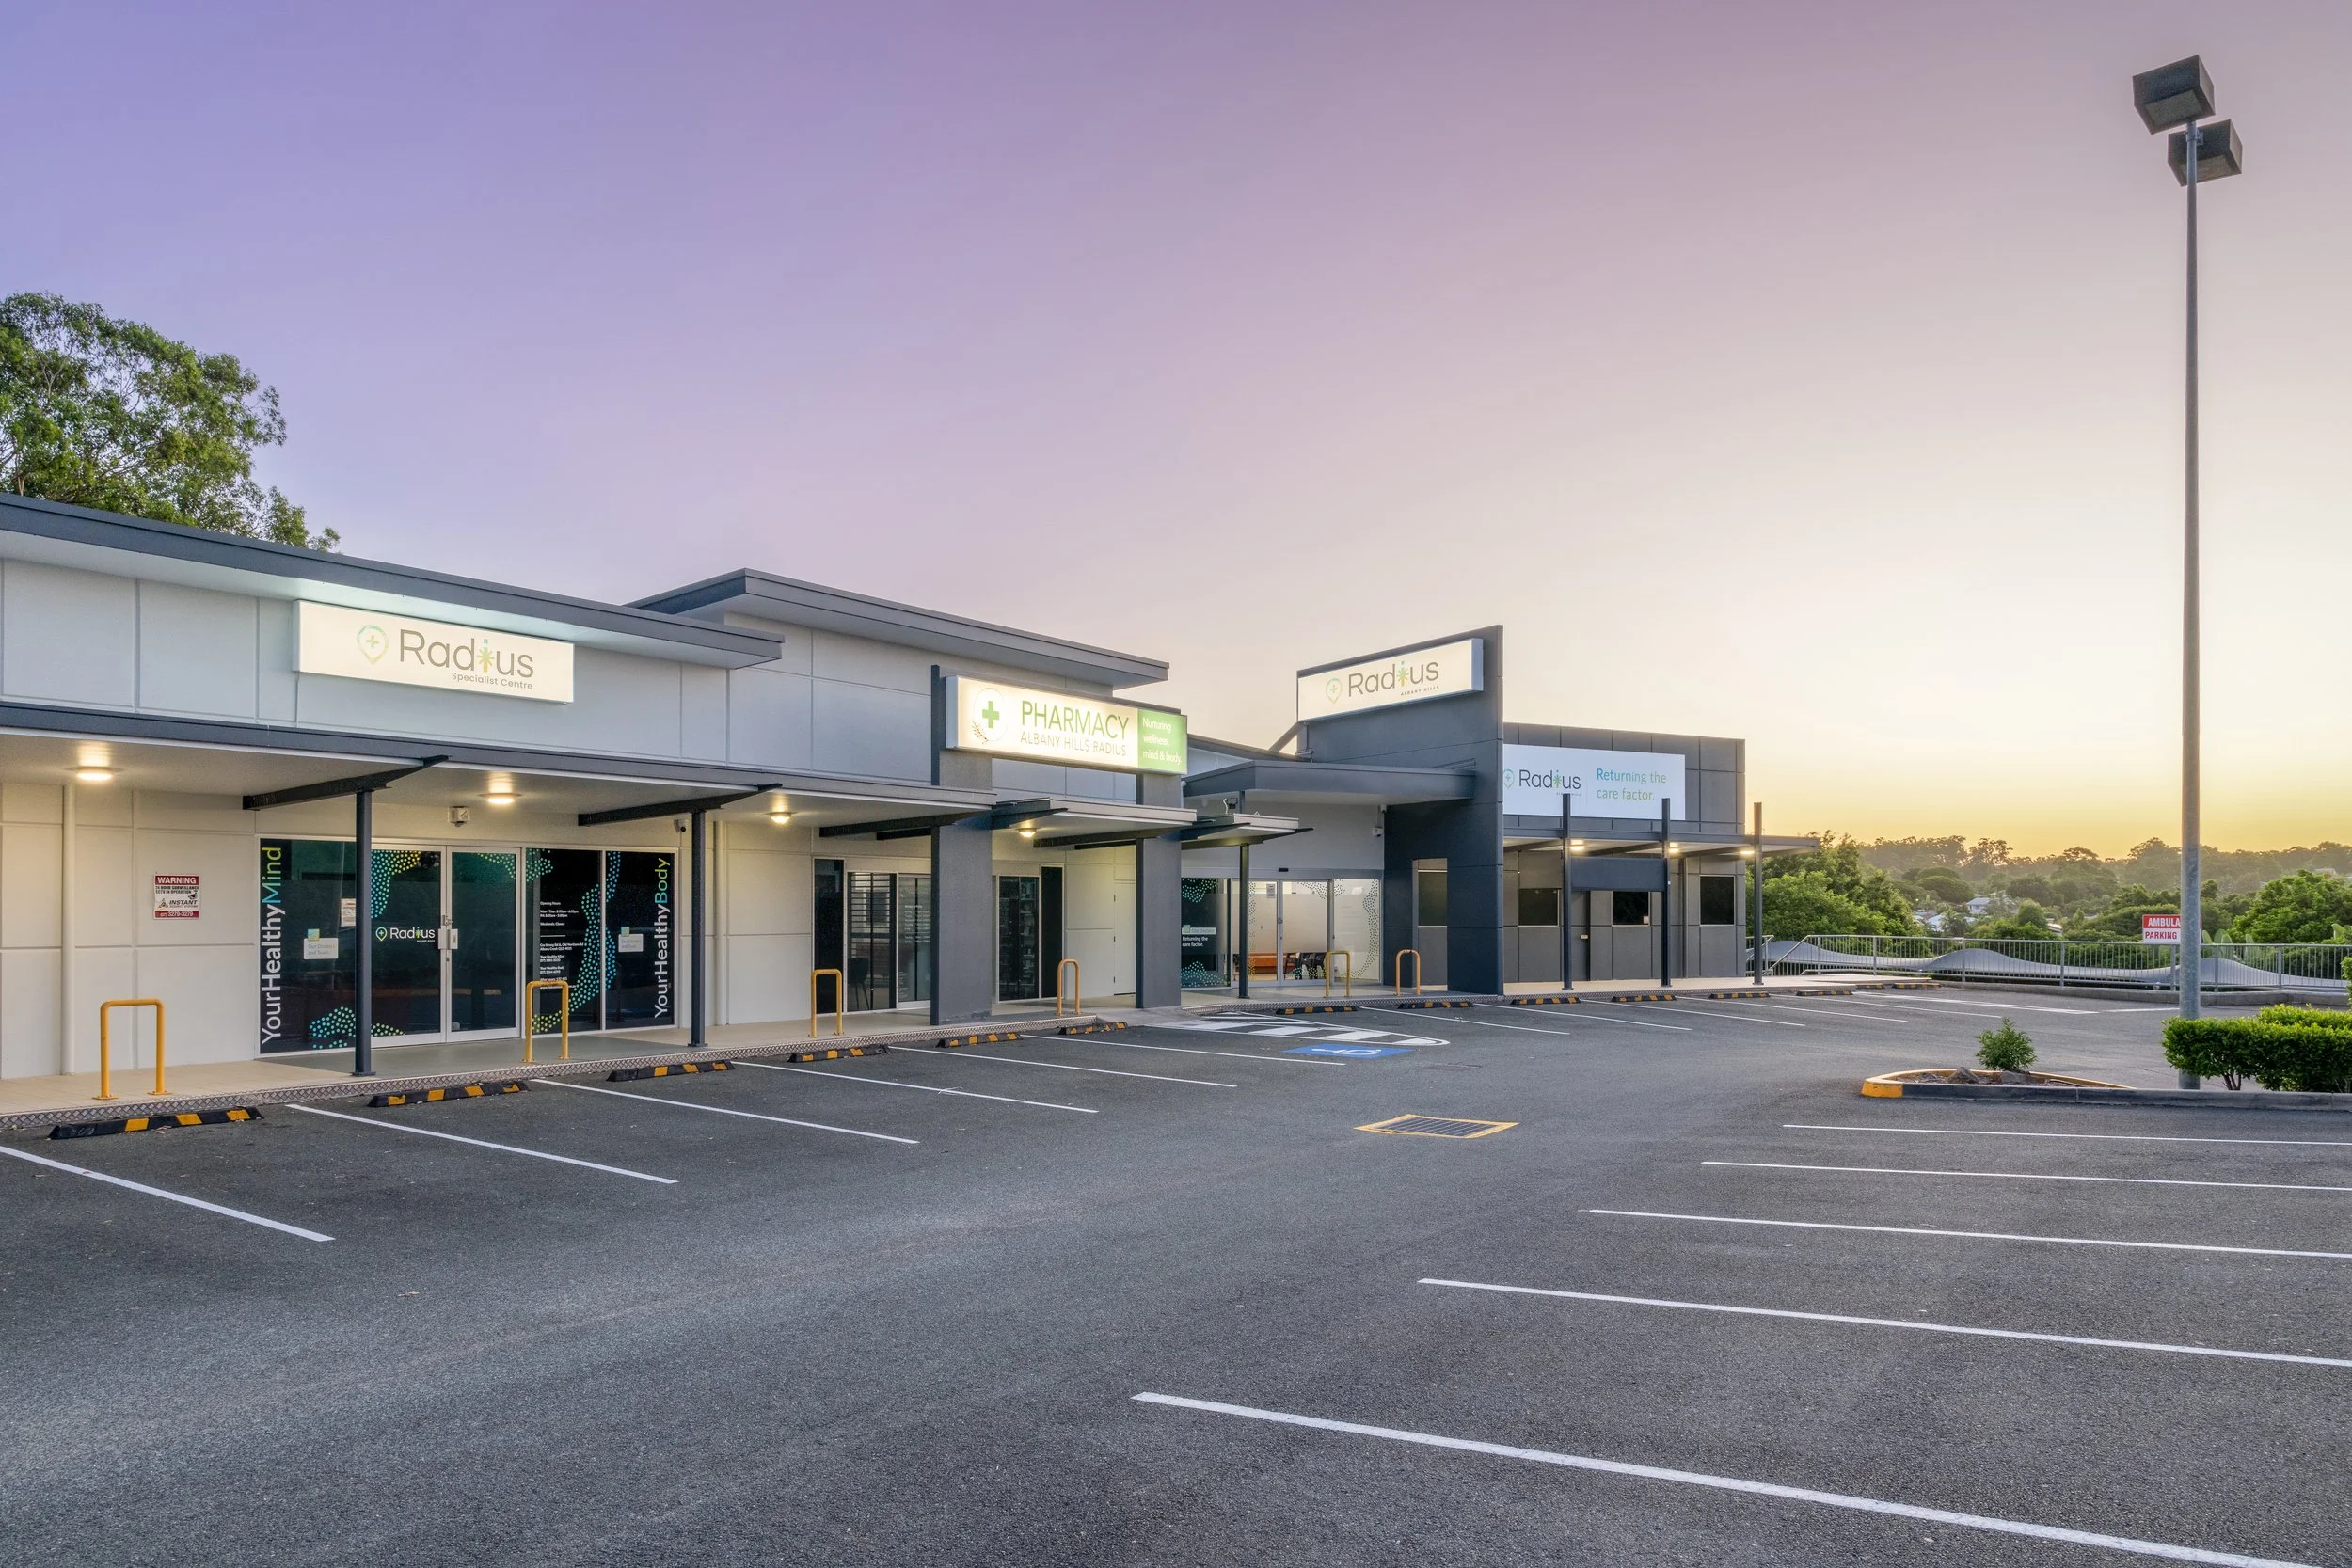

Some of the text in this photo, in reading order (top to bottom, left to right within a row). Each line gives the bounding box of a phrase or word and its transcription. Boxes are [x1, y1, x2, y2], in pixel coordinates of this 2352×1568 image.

[400, 629, 534, 678] Radius
[452, 672, 533, 689] Specialist Centre
[1348, 660, 1440, 698] Radius
[1022, 700, 1129, 740] PHARMACY
[1142, 717, 1172, 734] Nurturing
[1020, 731, 1127, 756] ALBANY HILLS RADIUS
[1143, 734, 1170, 748] wellness,
[1143, 749, 1158, 760] mind
[1159, 751, 1166, 761] &
[1518, 769, 1581, 790] Radius
[1597, 768, 1667, 784] Returning the
[1597, 787, 1655, 800] care factor.
[2148, 917, 2182, 927] AMBULA
[389, 927, 436, 939] Radius
[2145, 931, 2177, 940] PARKING
